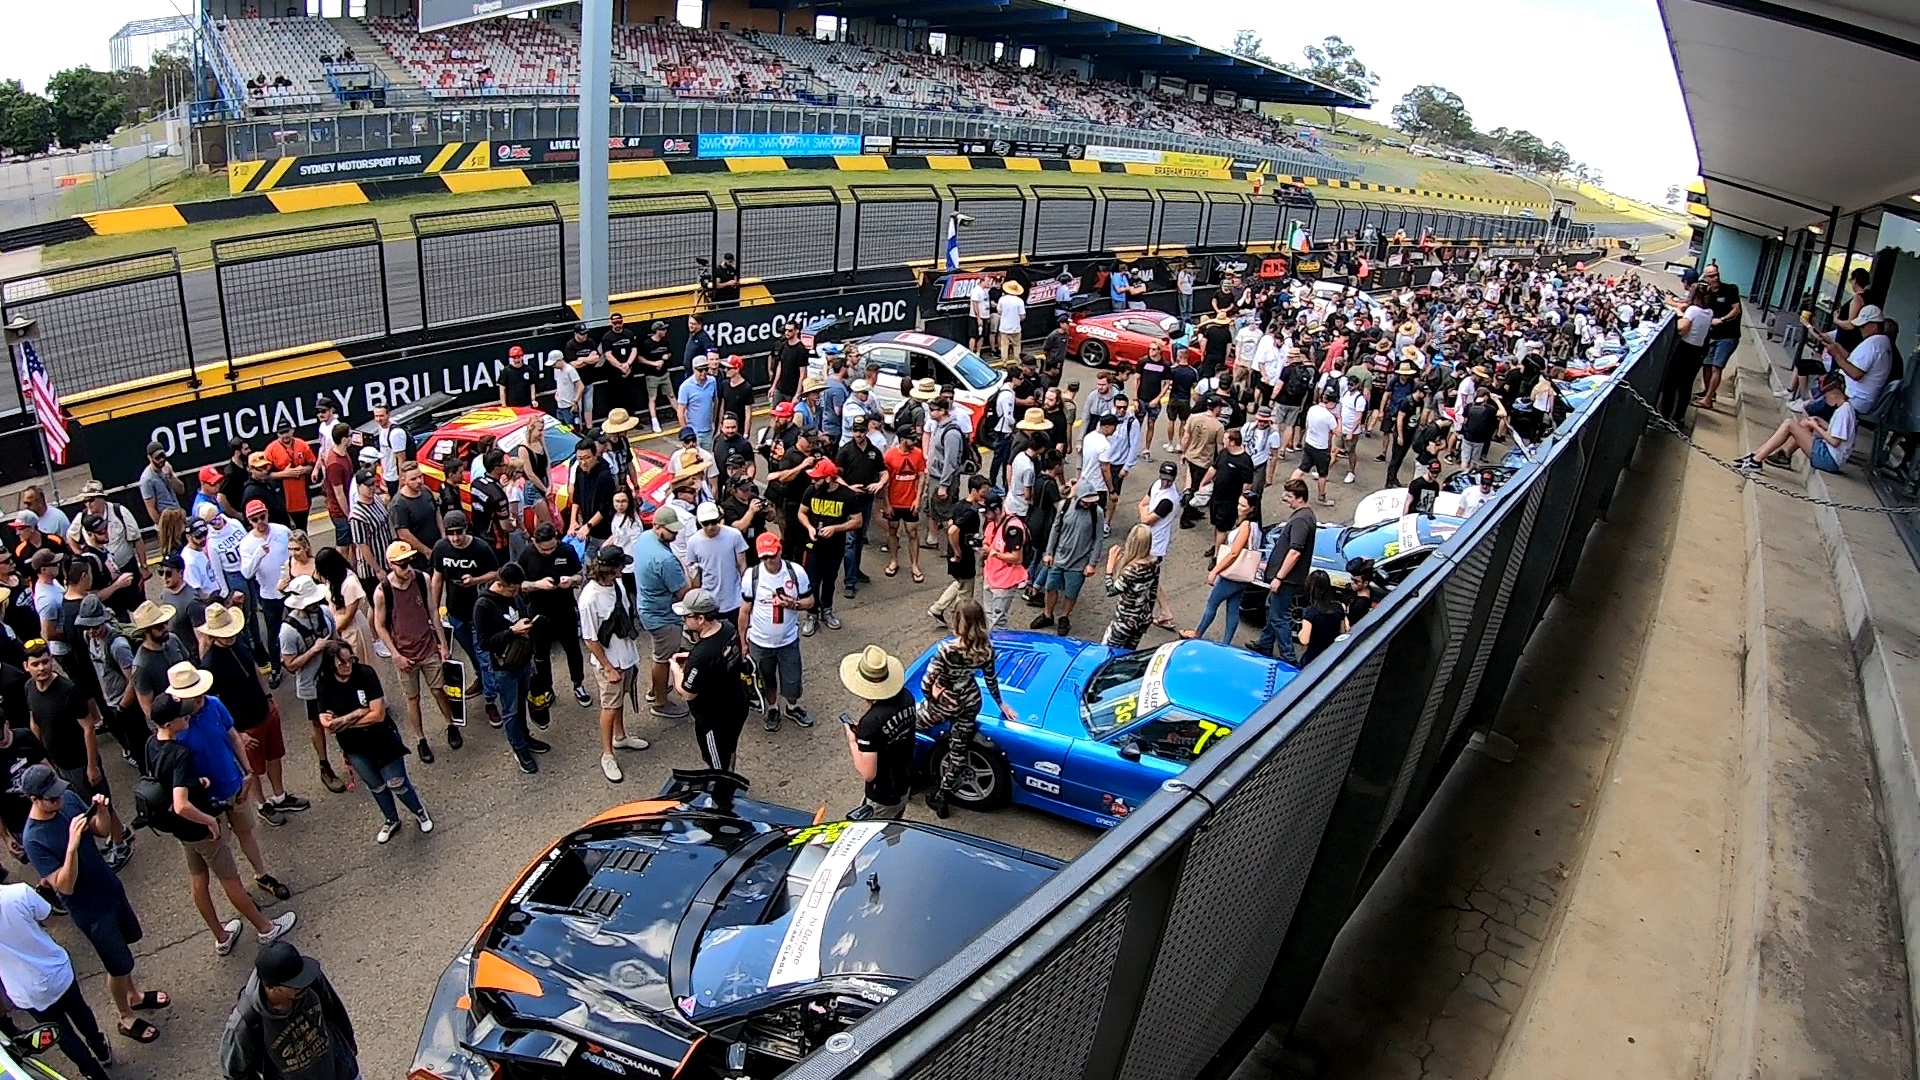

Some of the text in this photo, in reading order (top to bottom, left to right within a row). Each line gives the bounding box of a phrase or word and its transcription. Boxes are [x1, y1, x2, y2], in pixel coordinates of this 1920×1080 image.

[550, 140, 571, 150] LIVE
[628, 138, 641, 147] AT
[300, 154, 423, 176] SYDNEY MOTORSPORT PARK
[1154, 166, 1209, 178] BRABHAM STRAIGHT
[151, 385, 354, 459] OFFICIALY
[218, 529, 245, 553] SUPER
[443, 557, 478, 569] RVCA
[1151, 680, 1161, 709] CLUB
[1193, 719, 1232, 755] 7
[1026, 775, 1060, 795] GCG
[777, 944, 792, 975] CLASS
[603, 1049, 662, 1078] YOKOHAMA
